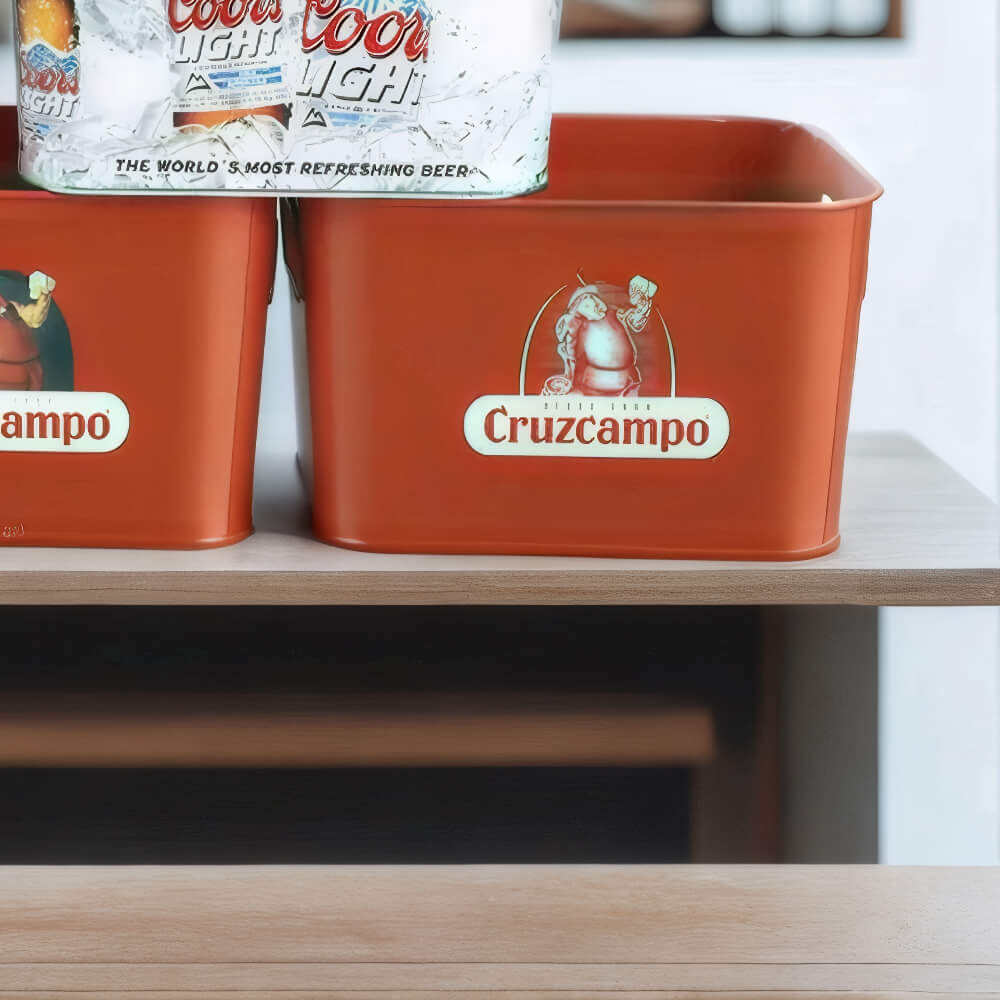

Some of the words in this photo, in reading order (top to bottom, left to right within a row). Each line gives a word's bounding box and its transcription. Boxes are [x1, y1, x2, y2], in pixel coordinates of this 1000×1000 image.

[175, 26, 284, 64] LIGHT
[116, 159, 151, 172] THE
[157, 159, 240, 174] WORLD'S
[244, 161, 295, 175] MOST
[300, 161, 415, 177] REFRESHING
[483, 405, 710, 452] Cruzcampo
